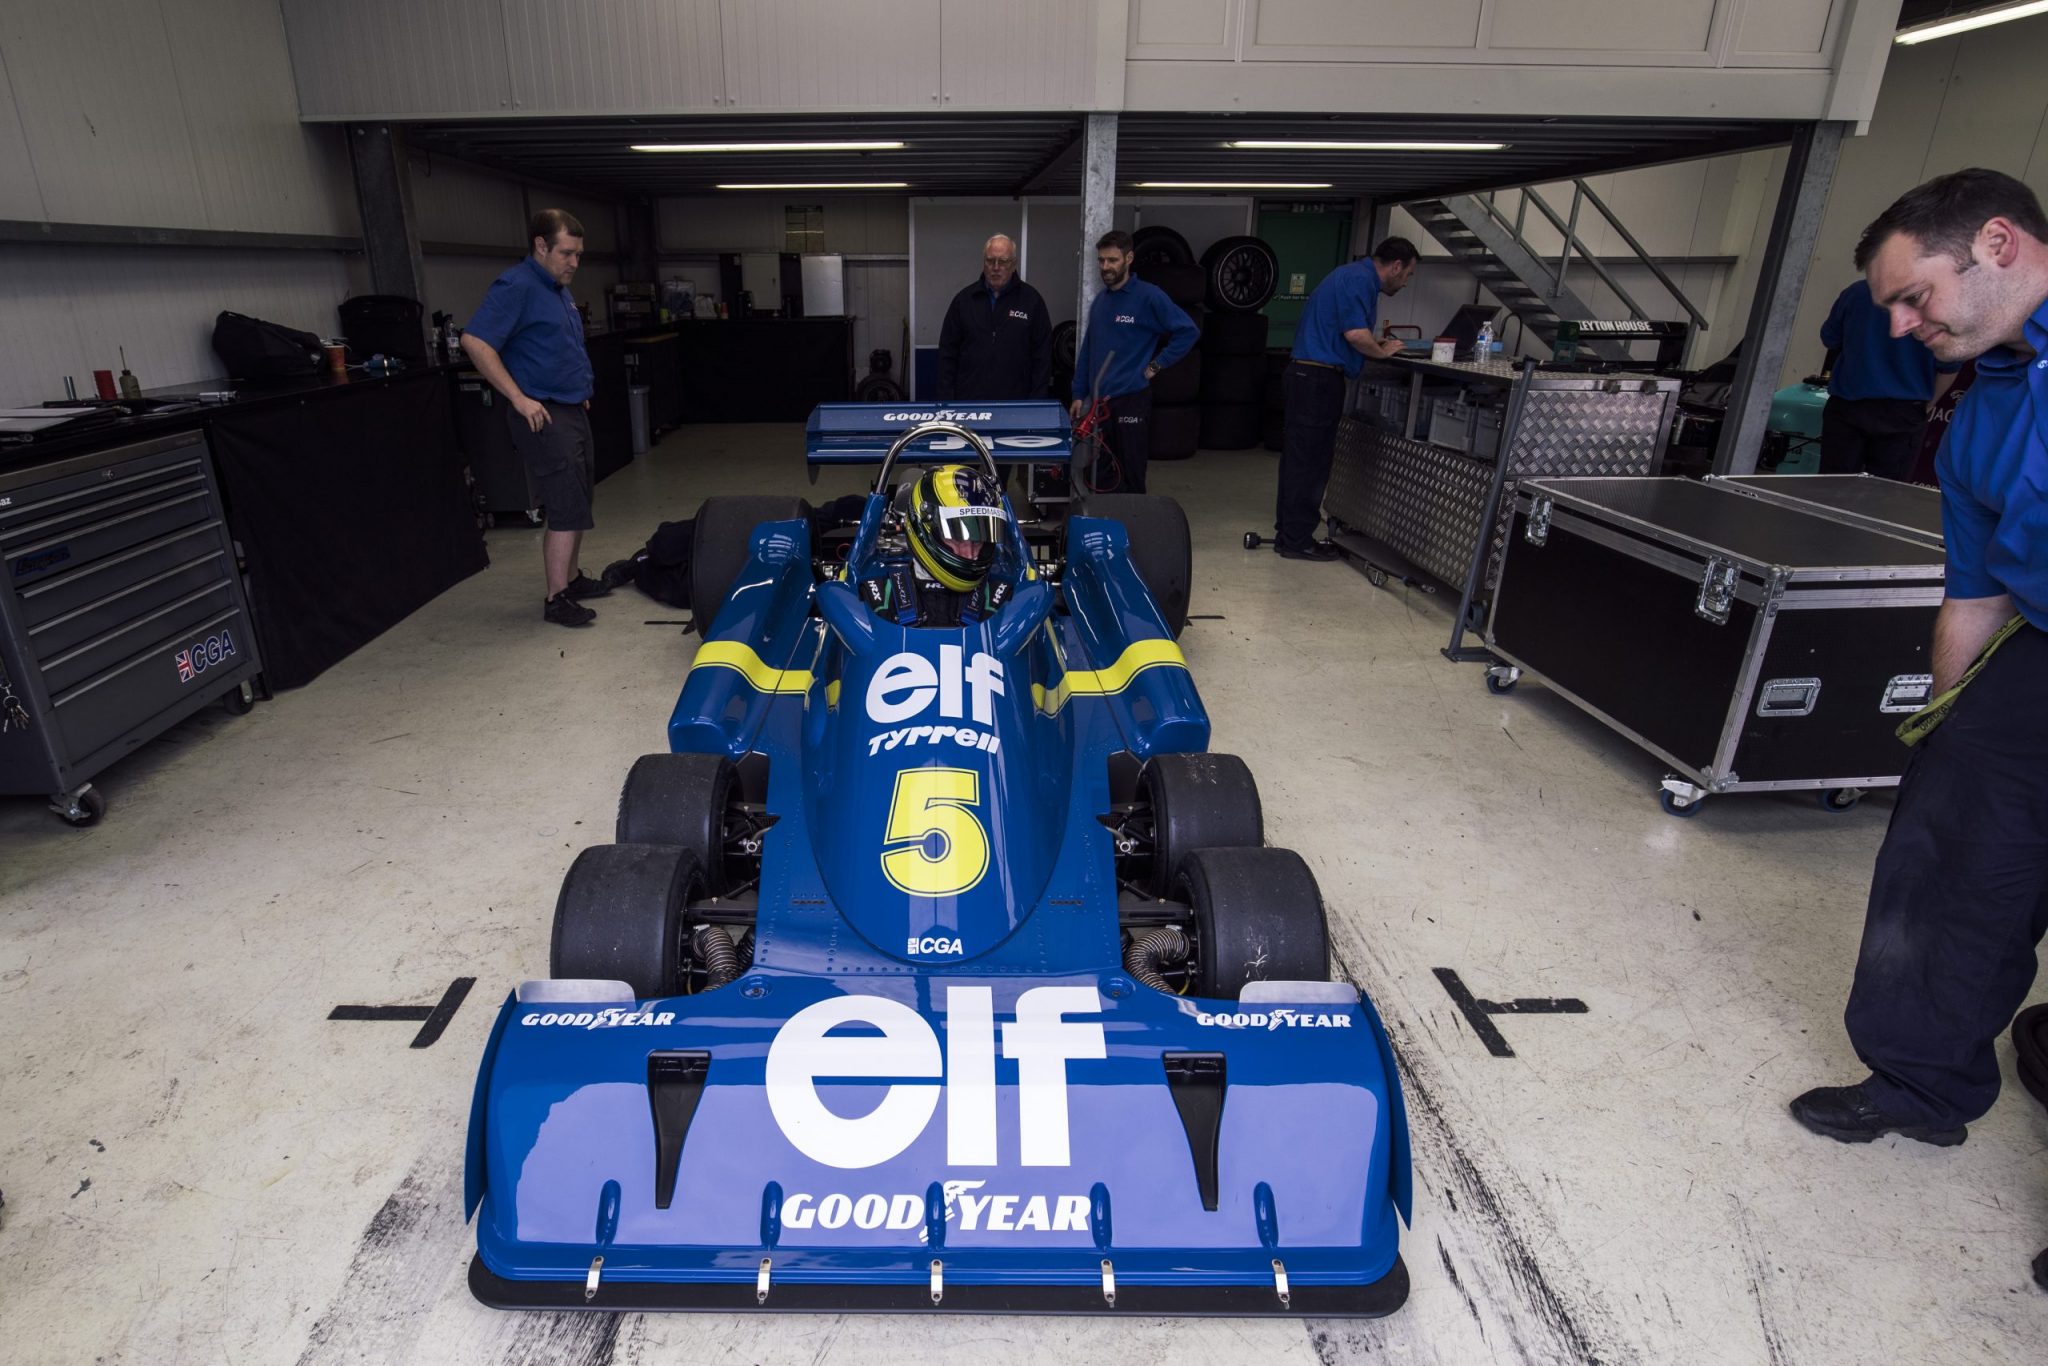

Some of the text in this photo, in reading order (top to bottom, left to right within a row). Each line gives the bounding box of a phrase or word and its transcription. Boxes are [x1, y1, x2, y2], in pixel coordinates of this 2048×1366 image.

[1014, 310, 1028, 320] CGA
[1120, 315, 1135, 324] CGA
[1580, 320, 1653, 331] LEYTON HOUSE
[1124, 416, 1138, 424] CGA
[867, 580, 882, 601] HRX
[993, 583, 1007, 604] HRX
[191, 629, 236, 673] CGA
[865, 644, 1005, 726] elf
[868, 725, 1001, 757] Tyrrell
[880, 767, 990, 897] 5
[919, 937, 963, 955] CGA
[765, 986, 1107, 1169] elf
